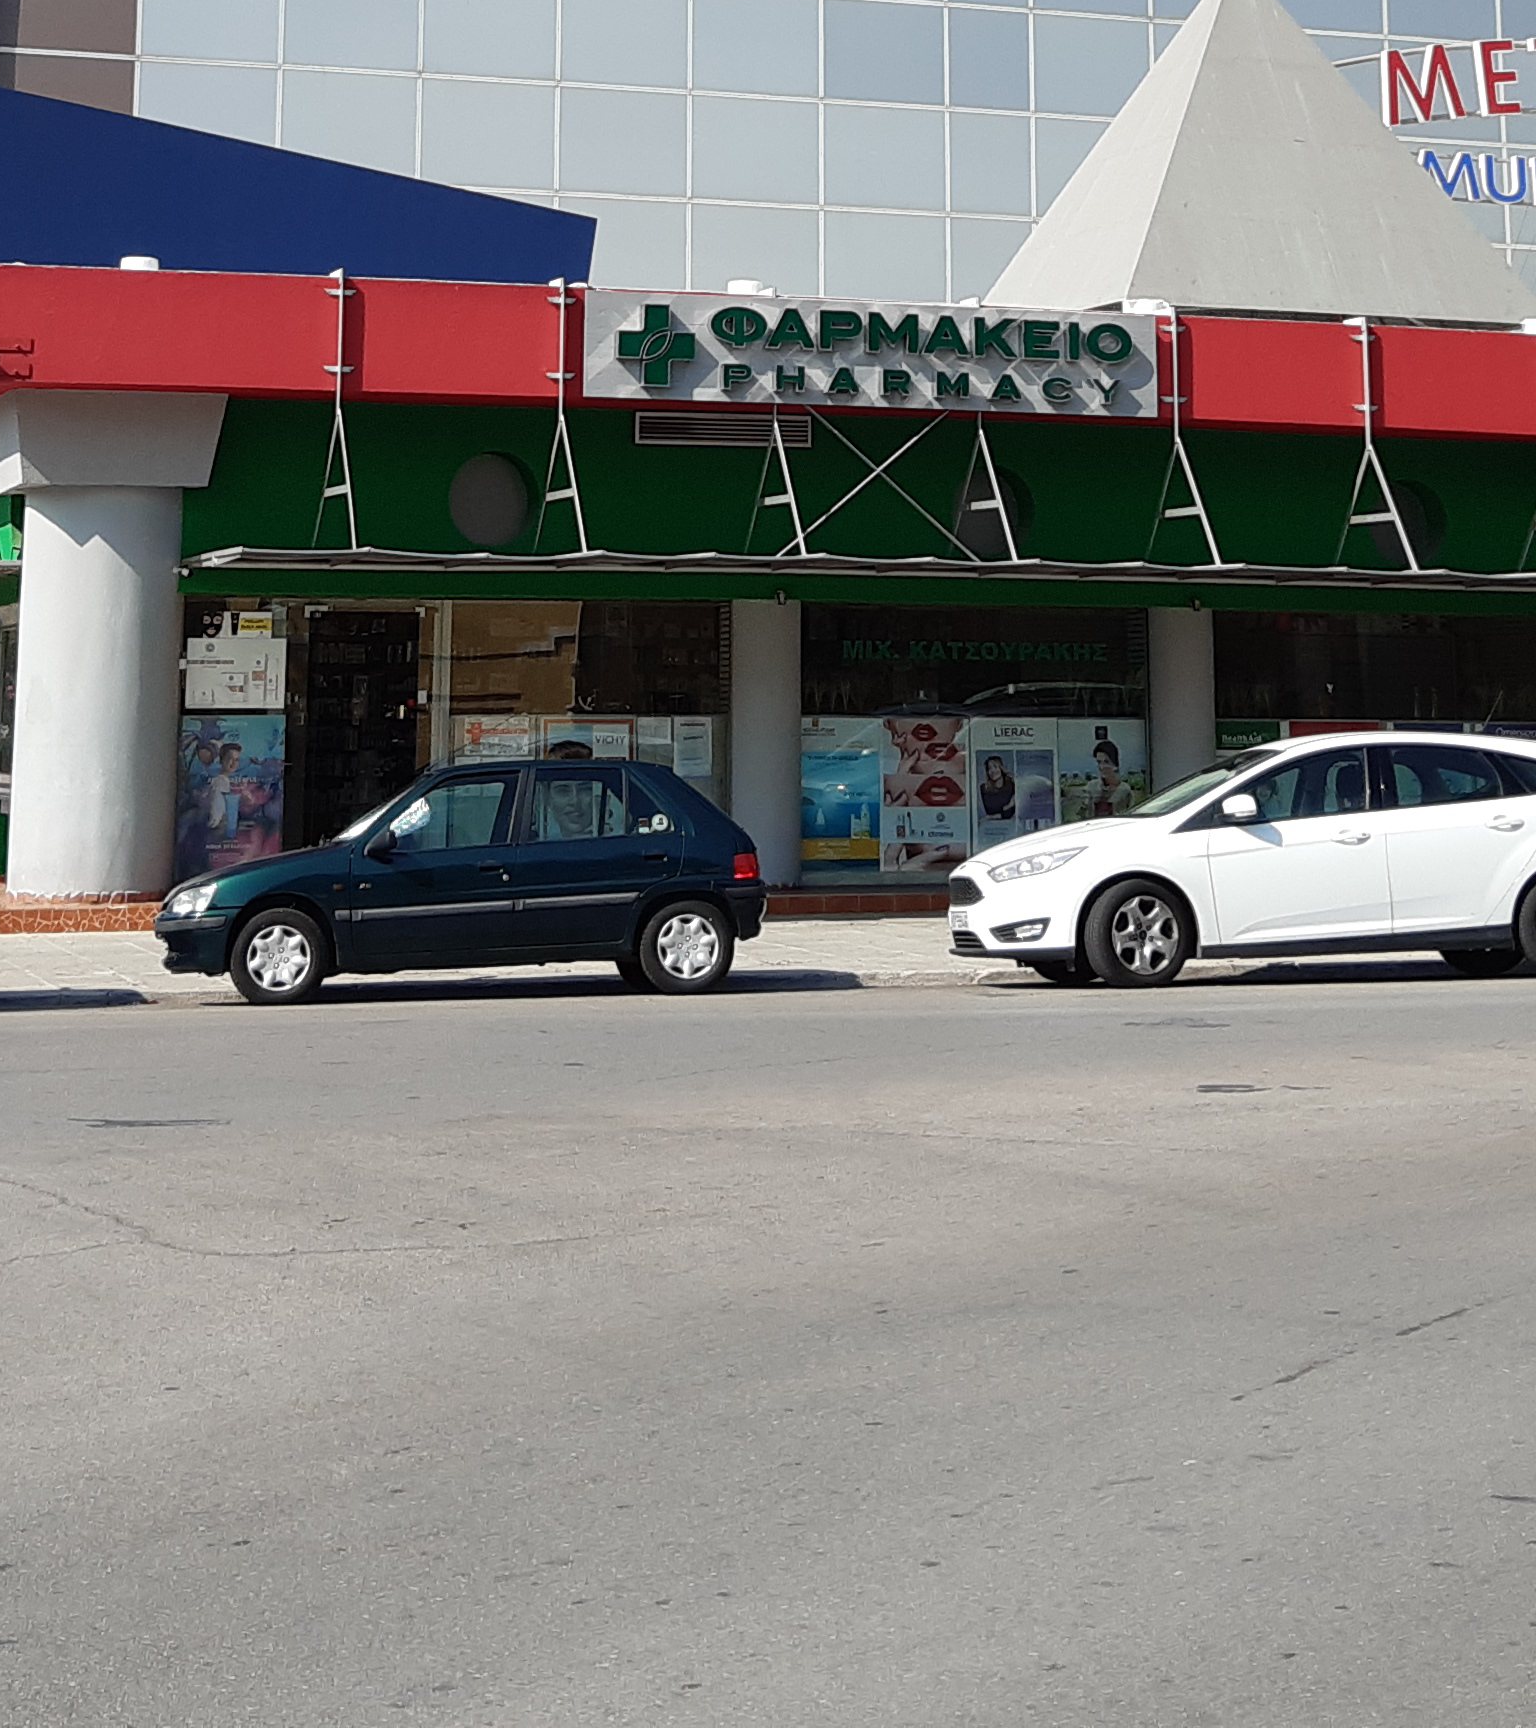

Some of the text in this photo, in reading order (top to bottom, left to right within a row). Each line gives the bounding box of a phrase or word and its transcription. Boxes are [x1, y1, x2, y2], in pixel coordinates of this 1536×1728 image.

[710, 306, 1134, 363] ΦΑΡΜΑΚΕΙΟ
[721, 363, 1122, 405] PHARMACY
[994, 727, 1034, 738] LIERAC
